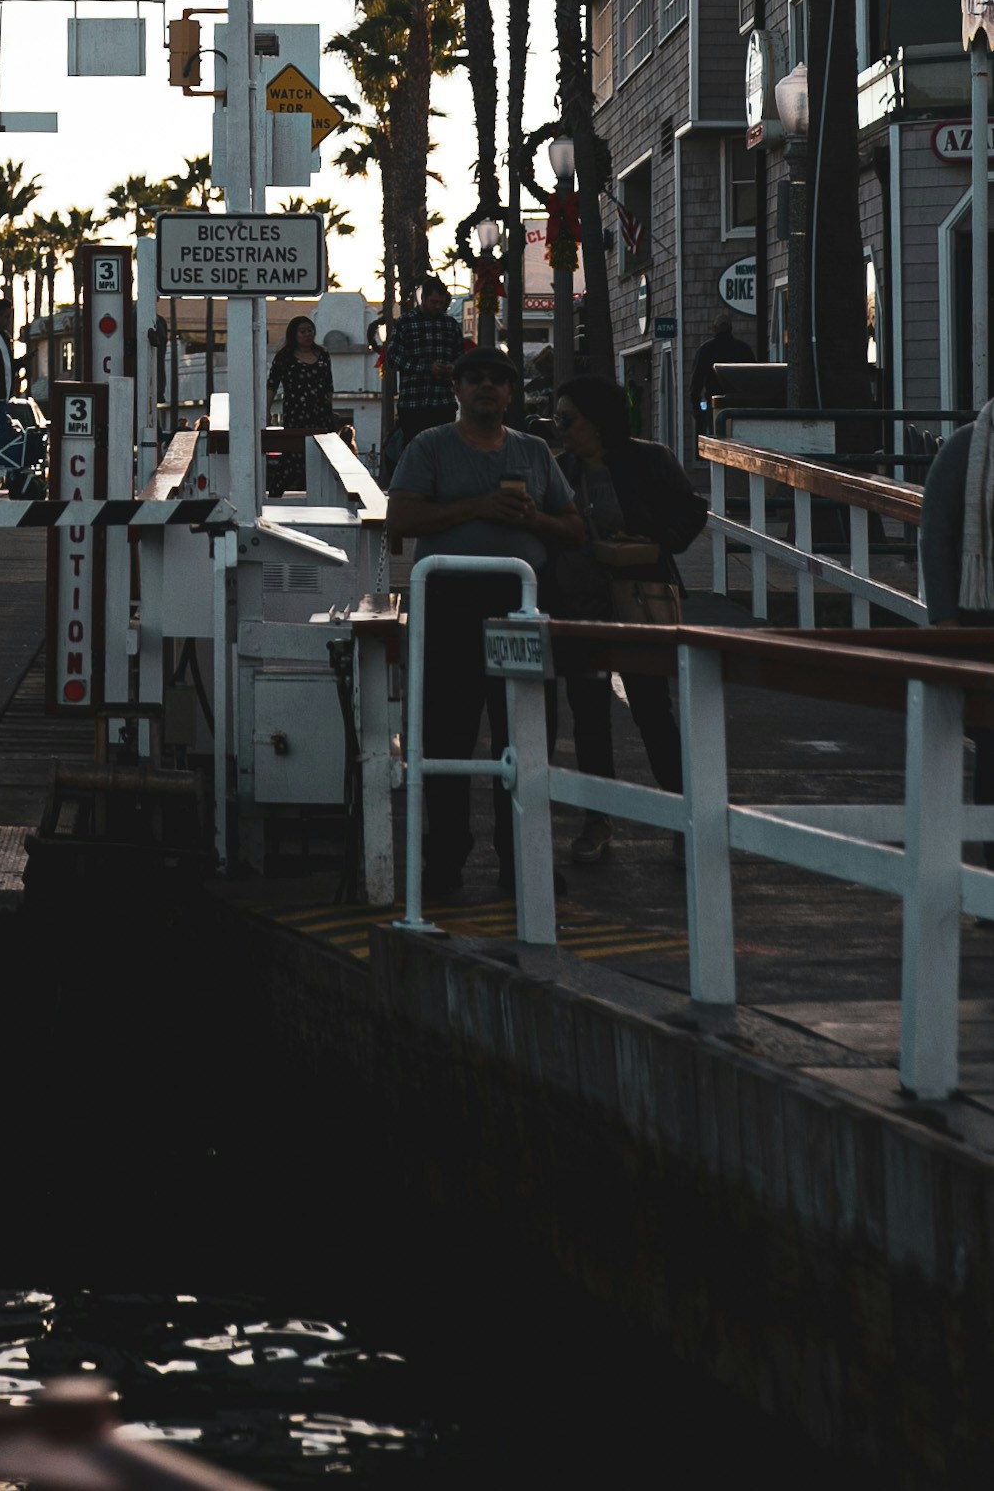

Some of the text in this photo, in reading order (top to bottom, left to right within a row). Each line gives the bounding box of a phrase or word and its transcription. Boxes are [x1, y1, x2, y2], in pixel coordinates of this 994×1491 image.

[270, 89, 312, 99] WATCH
[279, 103, 303, 113] FOR
[197, 225, 281, 241] BICYCLES
[180, 246, 298, 263] PEDESTRIANS
[99, 262, 114, 280] 3
[170, 268, 308, 284] USE SIDE RAMP
[98, 281, 115, 289] MPH
[726, 278, 754, 300] BIKE
[69, 399, 88, 421] 3
[68, 422, 88, 433] MPH
[509, 636, 526, 662] YOUR
